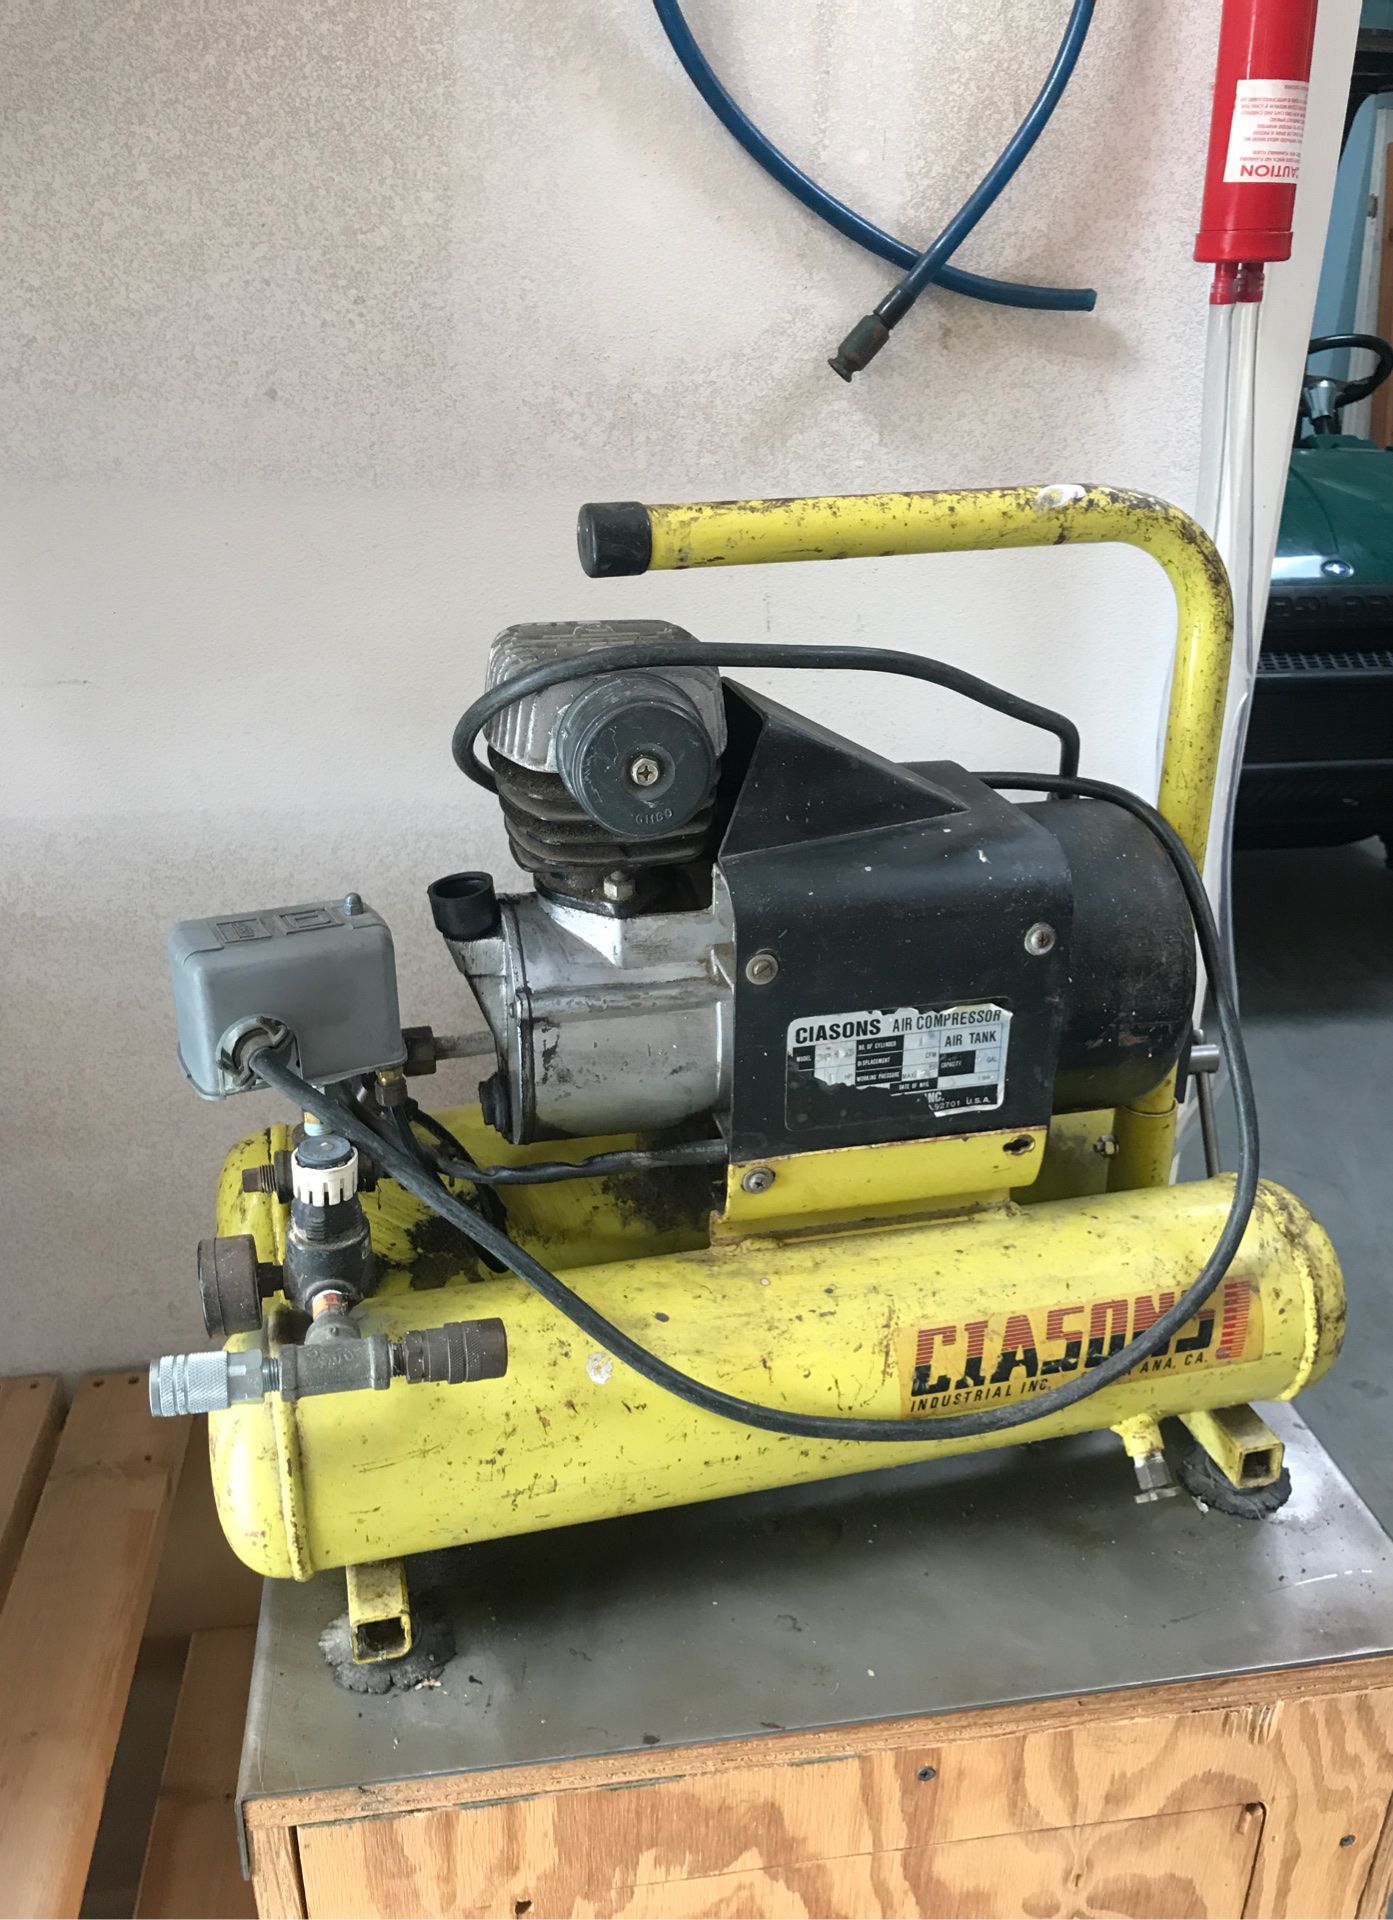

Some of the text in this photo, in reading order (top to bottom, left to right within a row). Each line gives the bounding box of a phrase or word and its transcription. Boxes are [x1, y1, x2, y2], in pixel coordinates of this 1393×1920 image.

[795, 1009, 1002, 1044] CIASONS AIR COMPRESSOR
[944, 1031, 997, 1047] AIR TANK
[910, 1385, 1012, 1413] INDUSTRIAL
